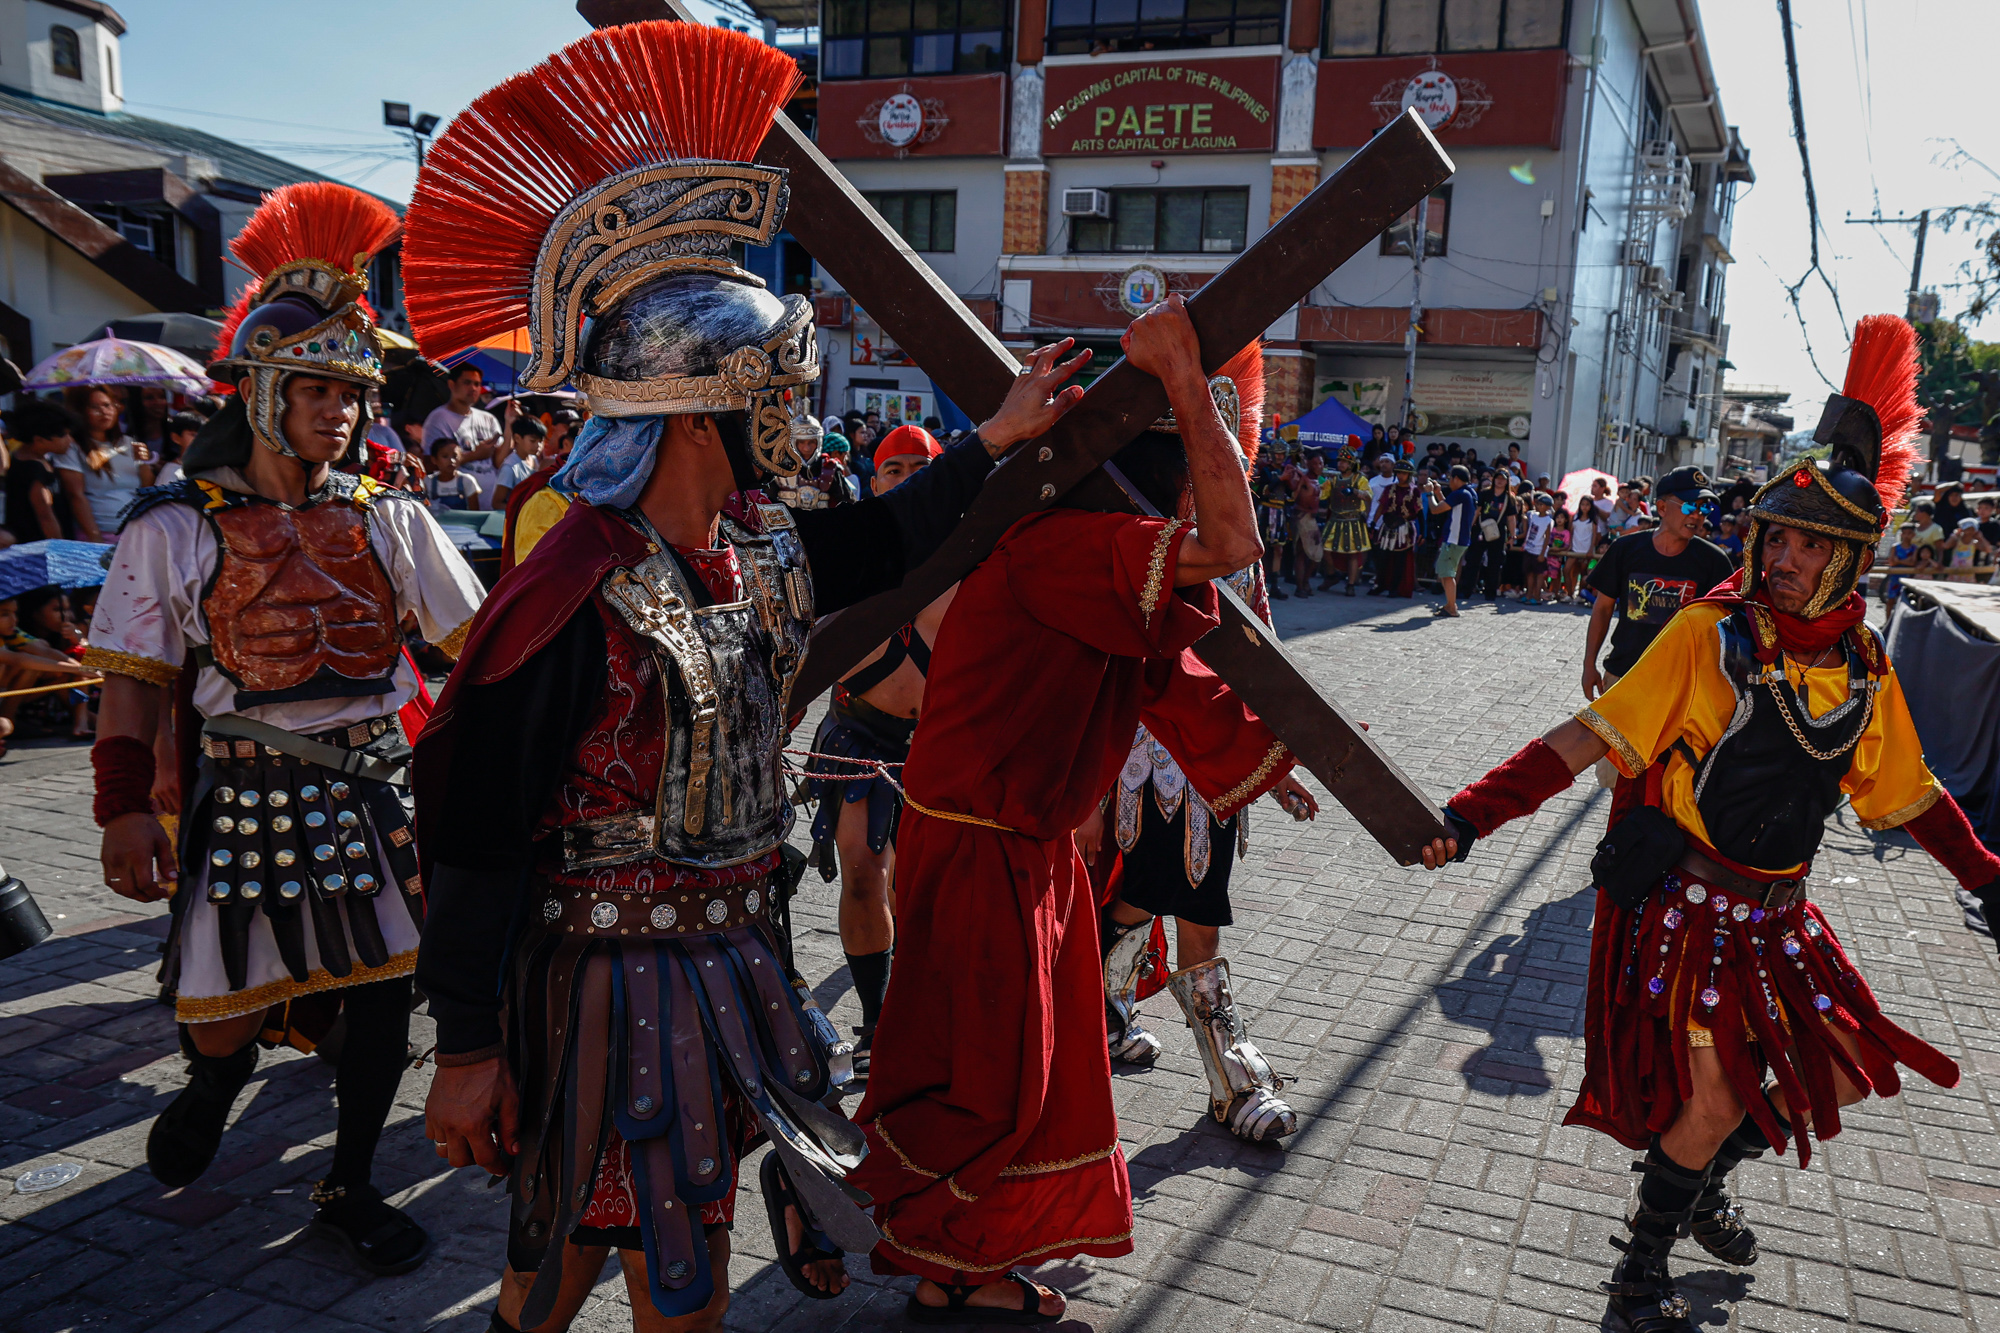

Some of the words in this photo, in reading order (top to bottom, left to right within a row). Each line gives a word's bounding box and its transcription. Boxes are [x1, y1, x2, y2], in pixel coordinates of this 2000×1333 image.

[1045, 105, 1067, 129] THE
[1066, 78, 1112, 112] CARVING
[1114, 67, 1163, 87] CAPITAL
[1166, 67, 1183, 81] OF
[1186, 69, 1209, 87] THE
[1209, 75, 1270, 124] PHILIPPINES
[1094, 104, 1213, 136] PAETE
[1071, 139, 1104, 152] ARTS
[1107, 138, 1160, 150] CAPITAL
[1162, 137, 1180, 149] OF
[1182, 136, 1237, 149] LAGUNA
